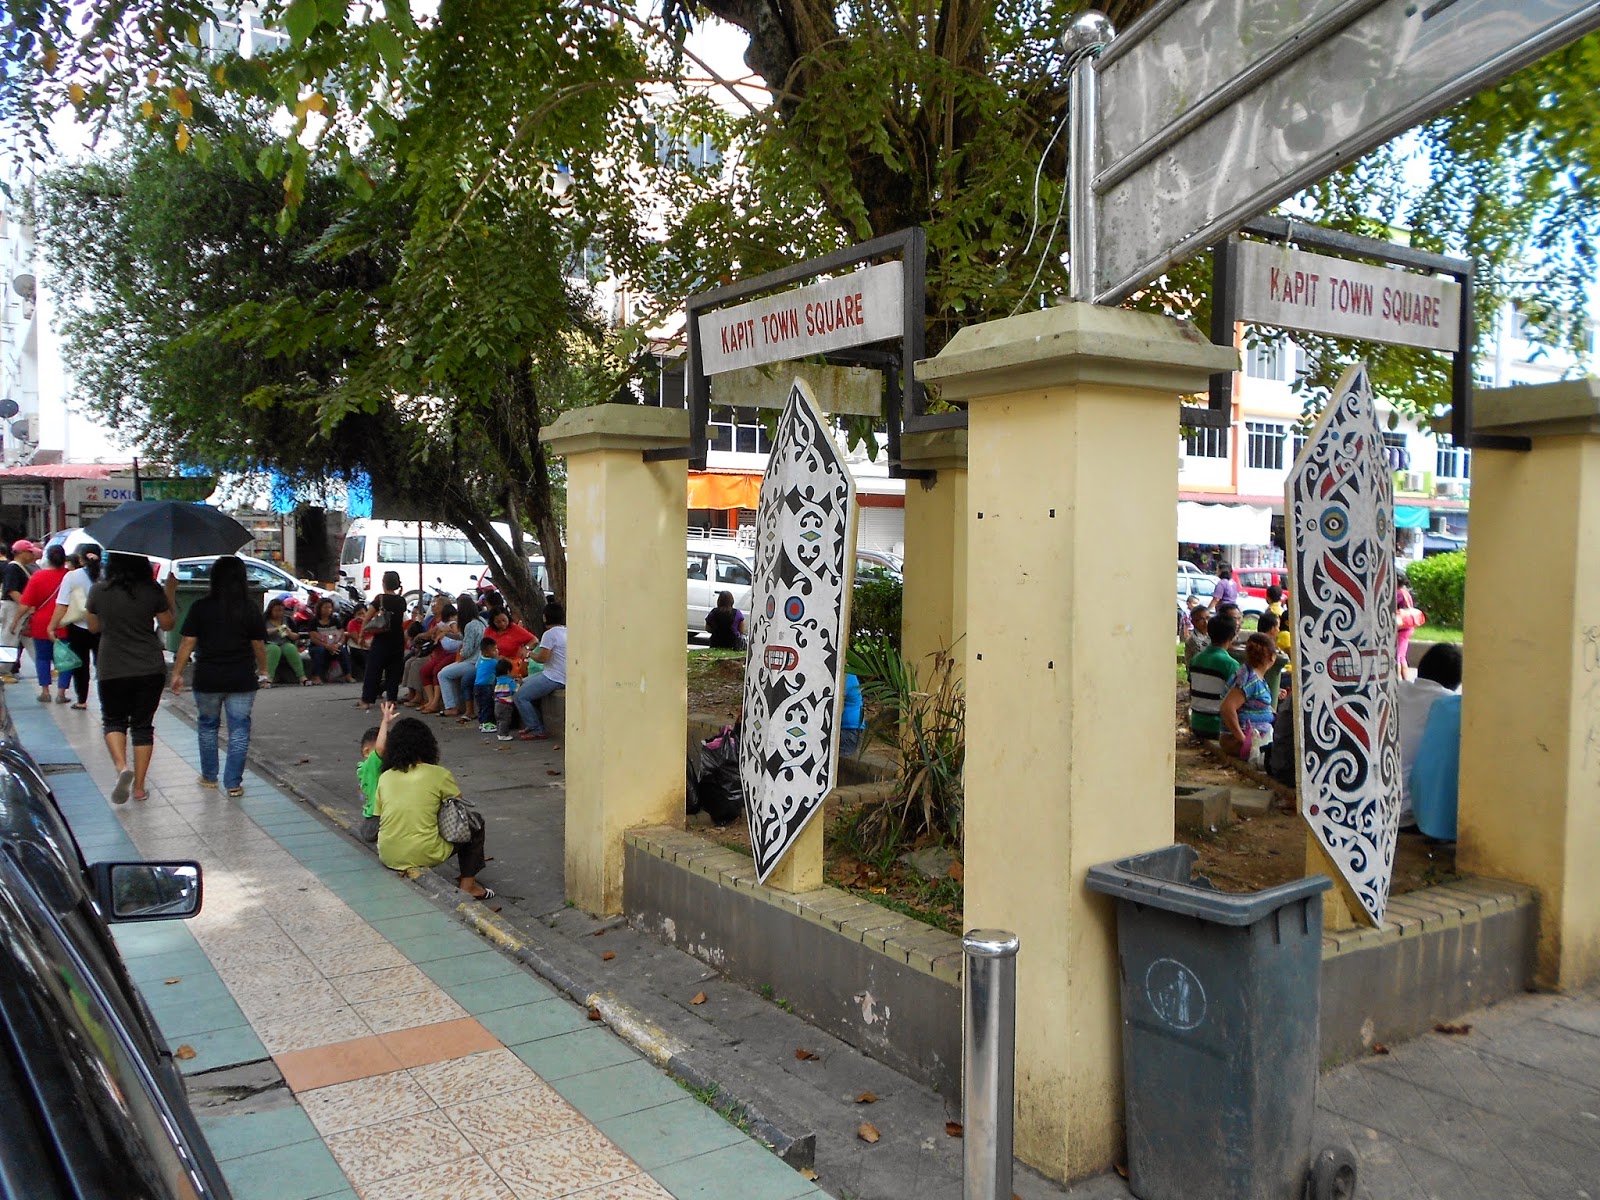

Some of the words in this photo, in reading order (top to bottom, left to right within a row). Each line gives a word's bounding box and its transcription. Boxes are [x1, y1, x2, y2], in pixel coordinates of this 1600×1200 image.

[721, 320, 754, 353] KAPIT
[761, 308, 799, 344] TOWN
[805, 293, 864, 336] SQUARE
[1270, 267, 1319, 307] KAPIT
[1329, 277, 1374, 316] TOWN
[1382, 287, 1441, 329] SQUARE
